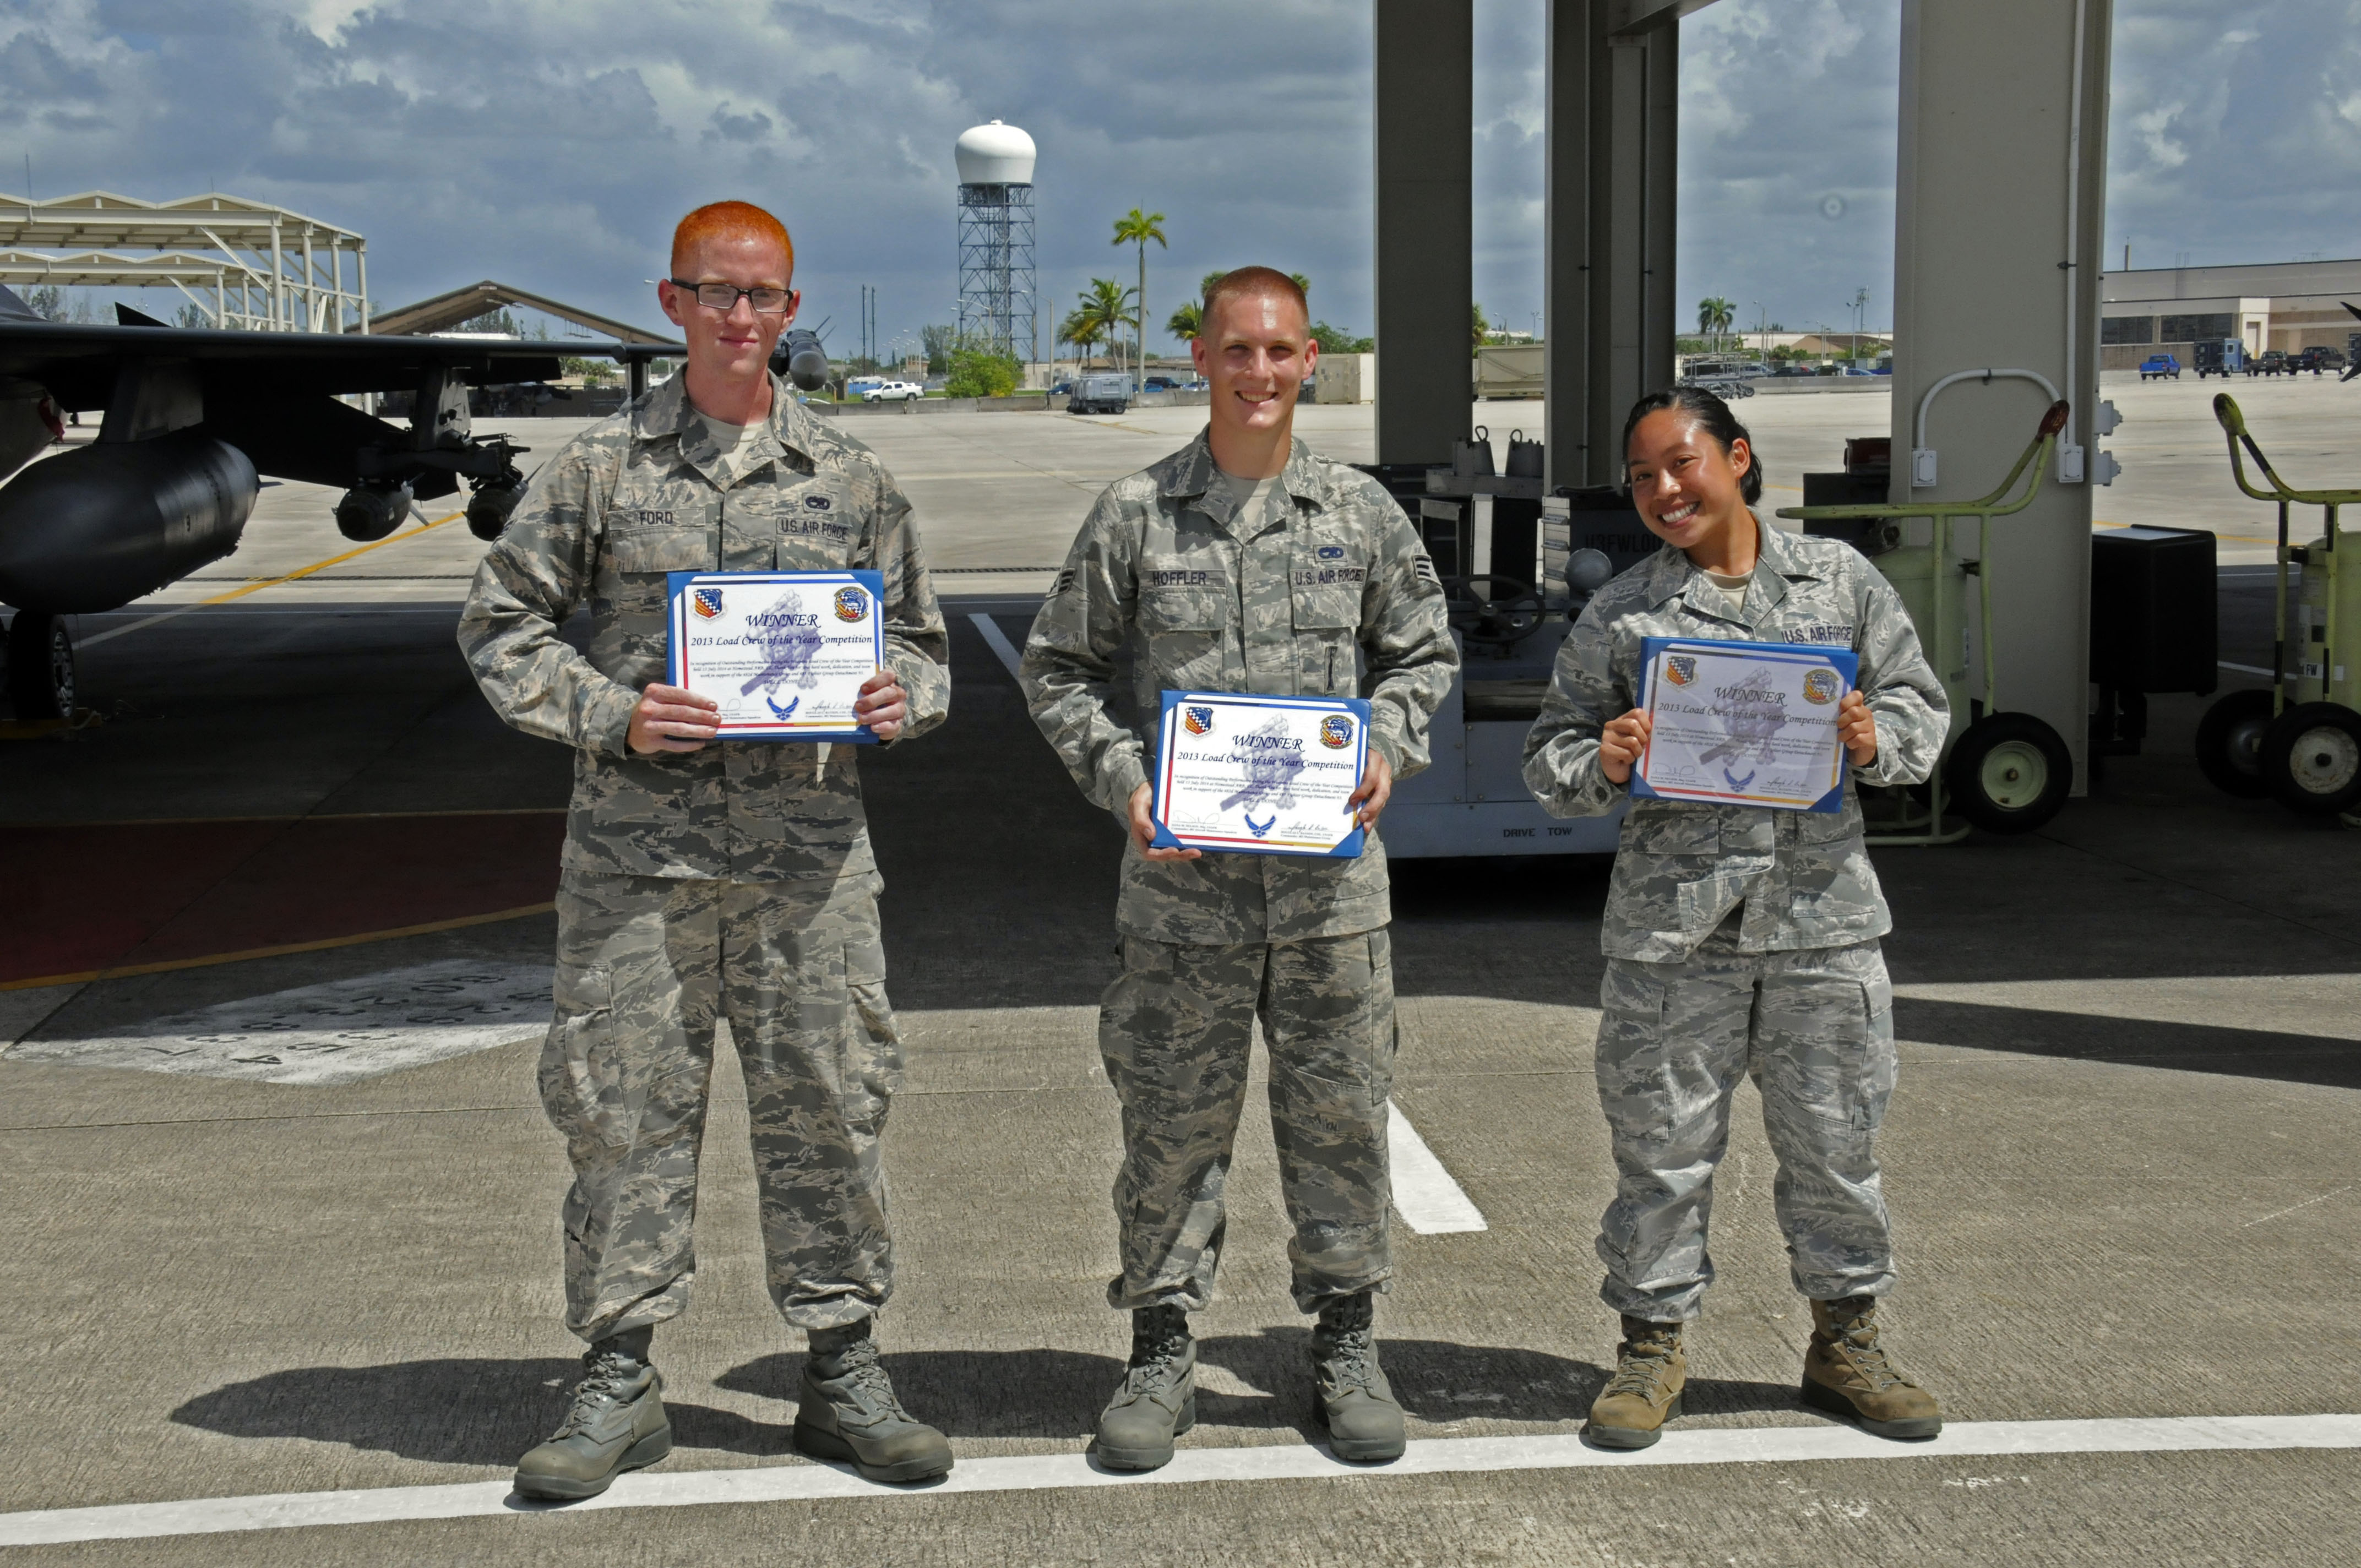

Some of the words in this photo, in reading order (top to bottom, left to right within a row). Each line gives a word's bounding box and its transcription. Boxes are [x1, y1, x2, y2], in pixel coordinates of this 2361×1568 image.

[639, 511, 673, 525] FORD
[781, 519, 797, 532] U.S.
[802, 520, 818, 535] AIR
[822, 522, 847, 541] FORCE
[1153, 571, 1207, 586] HOFFLER
[1295, 571, 1315, 585] U.S.
[1318, 569, 1336, 583] AIR
[1337, 568, 1364, 583] FORCE
[746, 613, 821, 628] WINNER
[691, 637, 713, 646] 2013
[716, 635, 741, 645] Load
[742, 636, 765, 646] Crew
[768, 635, 779, 647] of
[779, 634, 793, 644] the
[796, 635, 817, 644] Year
[819, 634, 872, 646] Competition
[1784, 629, 1808, 644] U.S.
[1810, 627, 1827, 642] AIR
[1714, 686, 1787, 707] WINNER
[1658, 703, 1680, 712] 2013
[1682, 705, 1707, 715] Load
[1707, 706, 1731, 716] Crew
[1732, 709, 1744, 721] of
[1744, 710, 1758, 720] the
[1760, 712, 1782, 721] Year
[1782, 714, 1836, 726] Competition
[1232, 734, 1305, 752] WINNER
[1177, 752, 1199, 760] 2013
[1201, 753, 1226, 762] Load
[1226, 754, 1250, 764] Crew
[1252, 755, 1263, 767] of
[1263, 755, 1276, 765] the
[1279, 757, 1300, 766] Year
[1301, 759, 1353, 770] Competition
[1503, 828, 1536, 837] DRIVE
[1547, 826, 1573, 836] TOW
